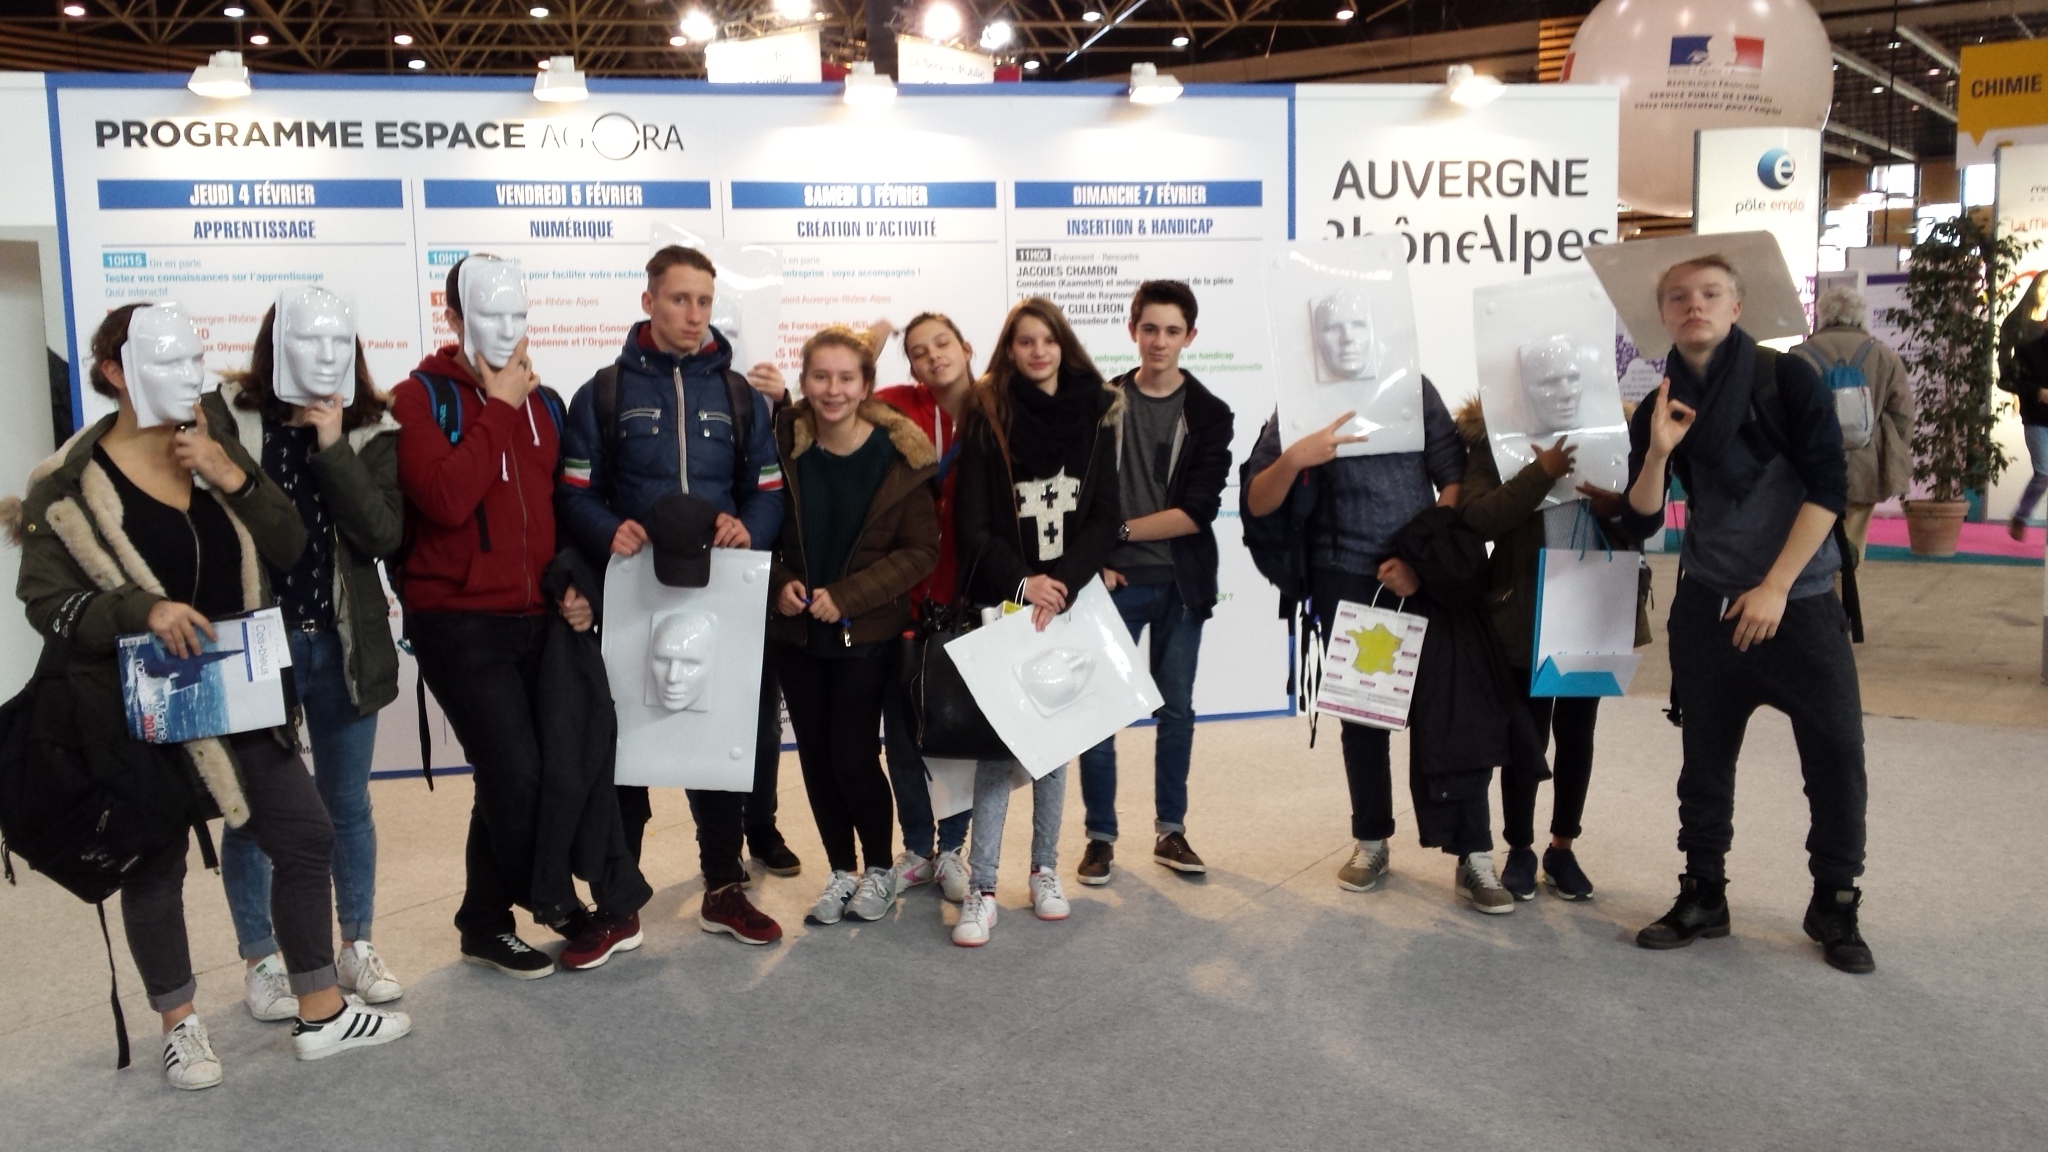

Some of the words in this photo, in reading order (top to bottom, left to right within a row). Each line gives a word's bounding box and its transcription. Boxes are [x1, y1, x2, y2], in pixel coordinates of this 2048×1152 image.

[1971, 73, 2042, 99] CHIMIE
[95, 119, 364, 149] PROGRAMME
[374, 121, 526, 149] ESPACE
[1332, 157, 1590, 200] AUVERGNE
[190, 184, 234, 206] JEUDI
[238, 184, 250, 206] 4
[254, 180, 316, 206] FÉVRIER
[495, 184, 567, 206] VENDREDI
[571, 184, 582, 206] 5
[585, 180, 643, 206] FÉVRIER
[803, 184, 858, 207] SAMEDI
[874, 182, 929, 207] FÉVRIER
[1072, 184, 1142, 206] DIMANCHE
[1144, 184, 1154, 206] 7
[1157, 181, 1207, 205] FÉVRIER
[1735, 197, 1766, 215] pôle
[193, 219, 317, 240] APPRENTISSAGE
[529, 215, 614, 239] NUMÉRIQUE
[797, 216, 861, 238] CRÉATION
[866, 216, 938, 238] D'ACTIVITÉ
[1066, 218, 1133, 236] INSERTION
[1137, 218, 1147, 235] &
[1151, 217, 1214, 235] HANDICAP
[105, 273, 135, 283] Testez
[137, 274, 155, 283] vos
[157, 272, 230, 283] connaissances
[231, 273, 247, 282] sur
[250, 271, 324, 283] l'apprentissage
[528, 272, 549, 281] pour
[552, 270, 586, 279] faciliter
[589, 271, 612, 279] votre
[832, 270, 855, 279] soyez
[1016, 266, 1064, 277] JACQUES
[1066, 265, 1118, 276] CHAMBON
[1016, 279, 1056, 288] Comédien
[1106, 279, 1115, 287] et
[1192, 277, 1202, 285] de
[1203, 277, 1211, 285] la
[1213, 277, 1234, 287] pièce
[105, 288, 126, 298] Quiz
[127, 287, 169, 297] interactif
[1053, 291, 1085, 300] Fauteuil
[1087, 291, 1097, 300] de
[527, 325, 550, 336] Open
[552, 324, 597, 334] Education
[367, 339, 394, 349] Paulo
[396, 341, 408, 349] en
[571, 338, 580, 347] et
[1198, 351, 1234, 362] handicap
